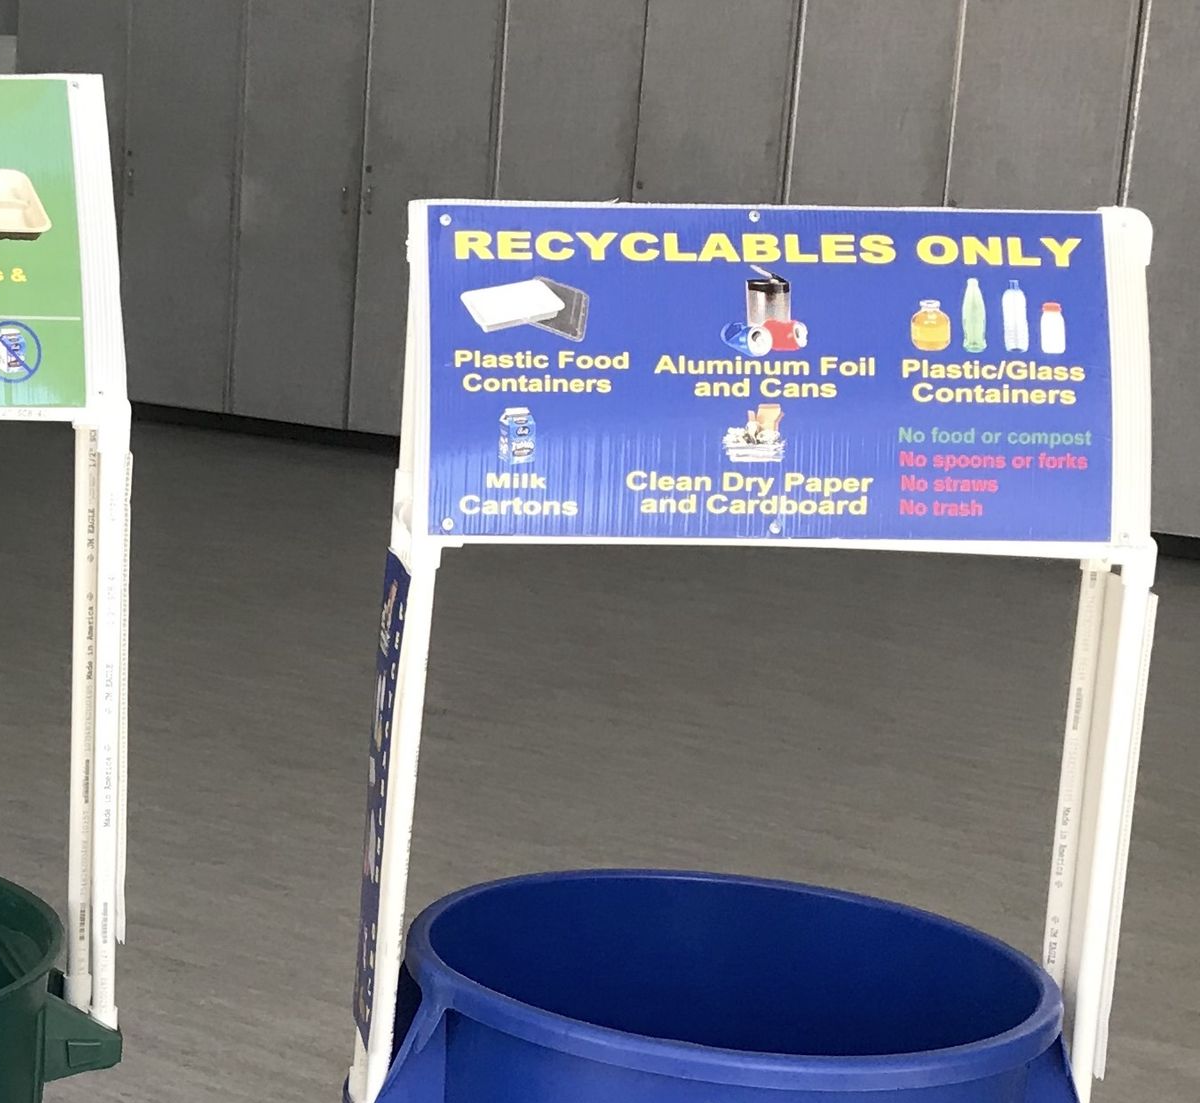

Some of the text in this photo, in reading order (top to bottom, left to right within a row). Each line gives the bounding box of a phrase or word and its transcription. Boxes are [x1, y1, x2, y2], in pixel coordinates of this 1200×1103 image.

[455, 231, 1080, 267] RECYCLABLES ONLY
[10, 268, 26, 282] &
[455, 350, 629, 370] Plastic Food
[655, 355, 875, 376] Aluminum Foil
[902, 359, 1085, 382] Plastic/Glass
[463, 373, 611, 393] Containers
[695, 377, 837, 397] and Cans
[912, 382, 1076, 404] Containers
[899, 427, 1092, 448] No food or compost
[900, 451, 1087, 471] No spoons or forks
[486, 473, 545, 488] Milk
[626, 470, 874, 496] Clean Dry Paper
[901, 475, 998, 492] No straws
[459, 495, 578, 516] Cartons
[640, 494, 868, 515] and Cardboard
[900, 499, 982, 517] No trash
